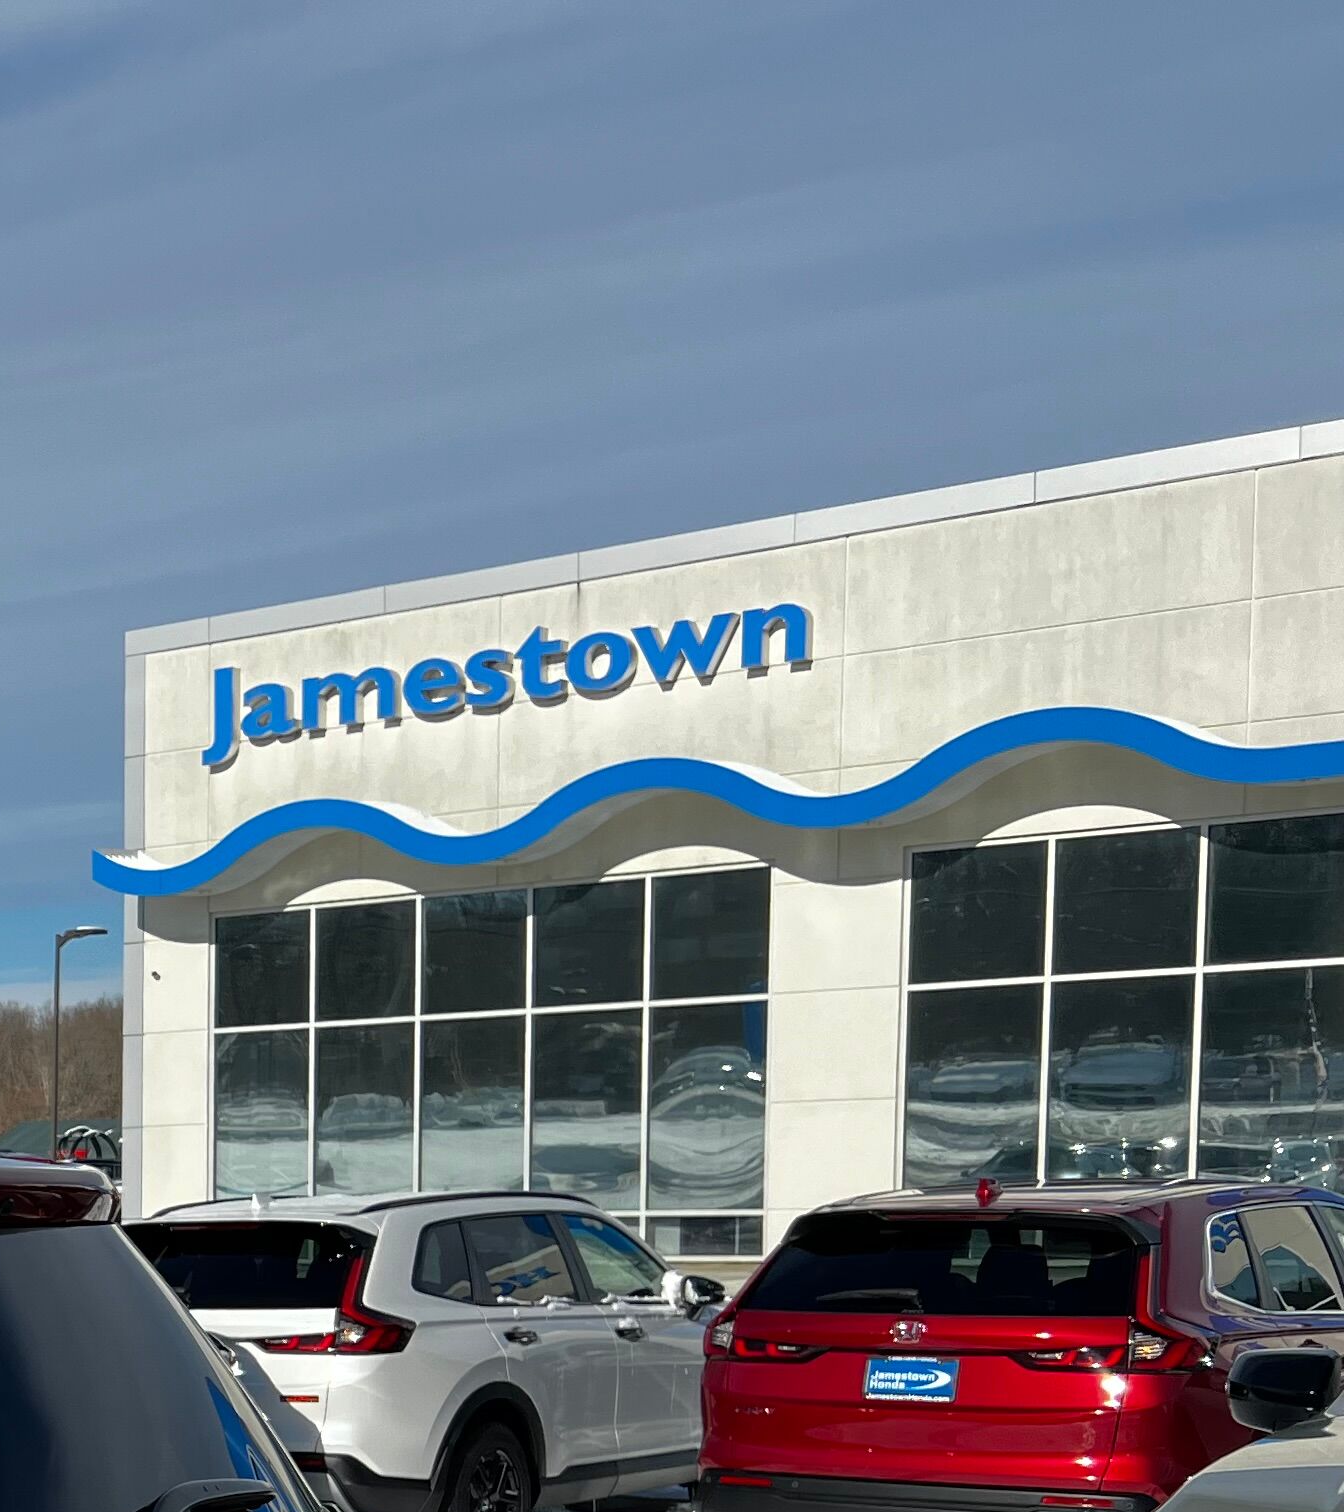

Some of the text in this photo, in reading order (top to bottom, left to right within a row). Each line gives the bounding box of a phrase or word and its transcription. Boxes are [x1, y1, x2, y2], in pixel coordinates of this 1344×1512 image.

[201, 602, 812, 771] Jamestown
[870, 1370, 935, 1382] Jamestown
[869, 1379, 906, 1390] Honda
